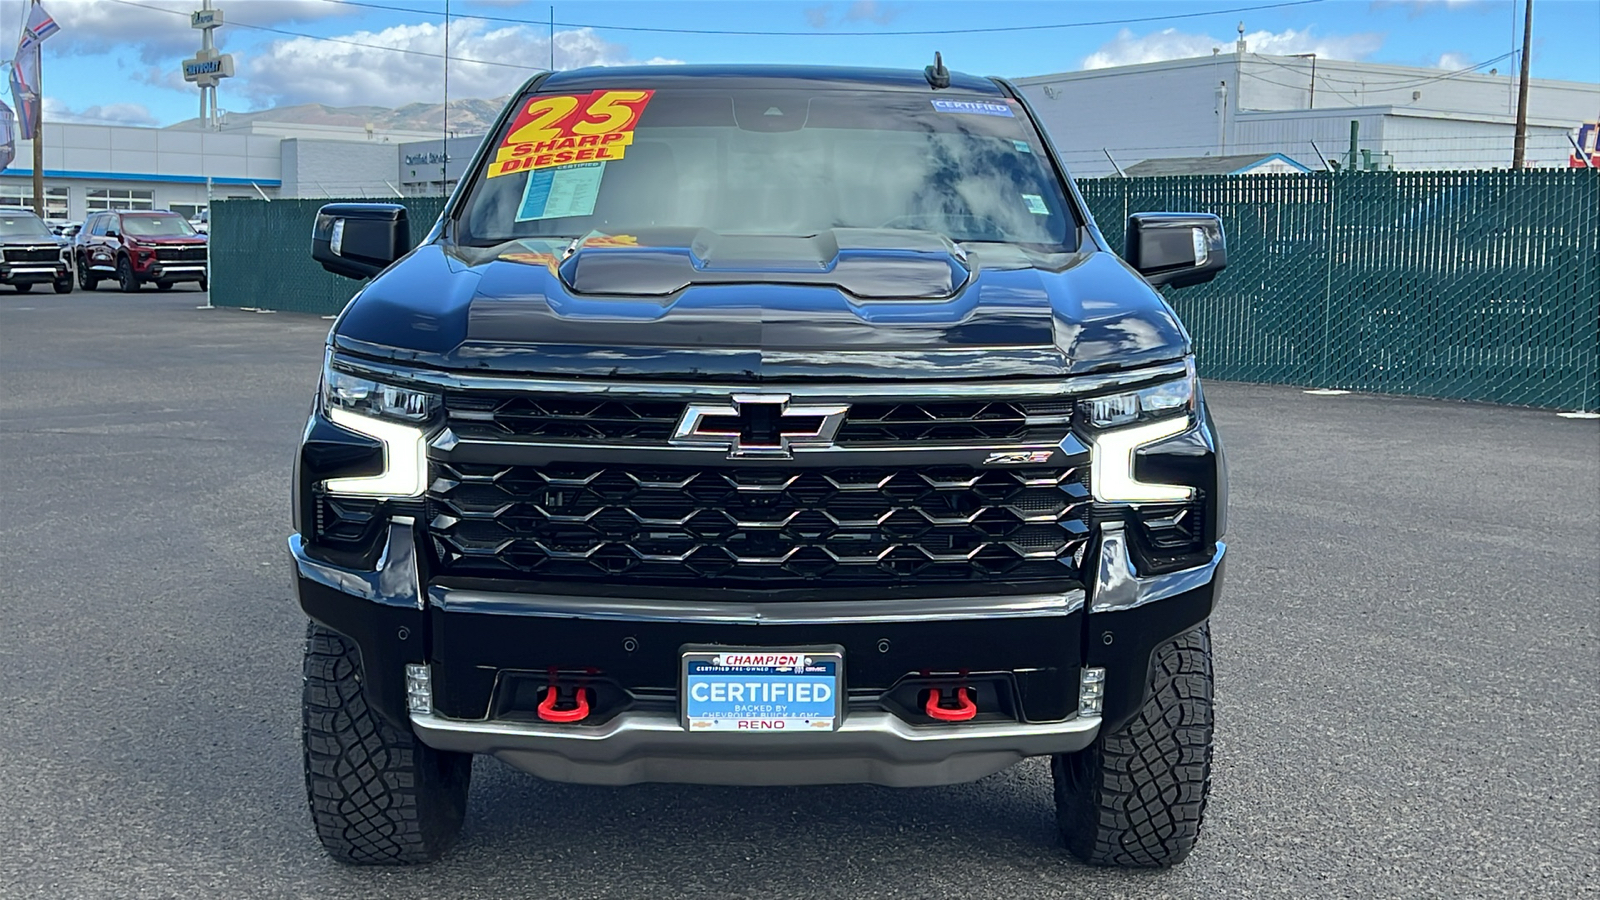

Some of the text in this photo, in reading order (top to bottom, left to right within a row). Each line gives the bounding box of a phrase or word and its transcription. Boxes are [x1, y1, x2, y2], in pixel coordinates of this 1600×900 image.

[935, 101, 1007, 112] CERTIFIED
[507, 91, 649, 144] 25
[511, 133, 623, 157] SHARP
[500, 147, 613, 174] DIESEL
[725, 655, 799, 666] CHAMPION
[691, 682, 832, 703] CERTIFIED
[738, 720, 785, 729] RENO
